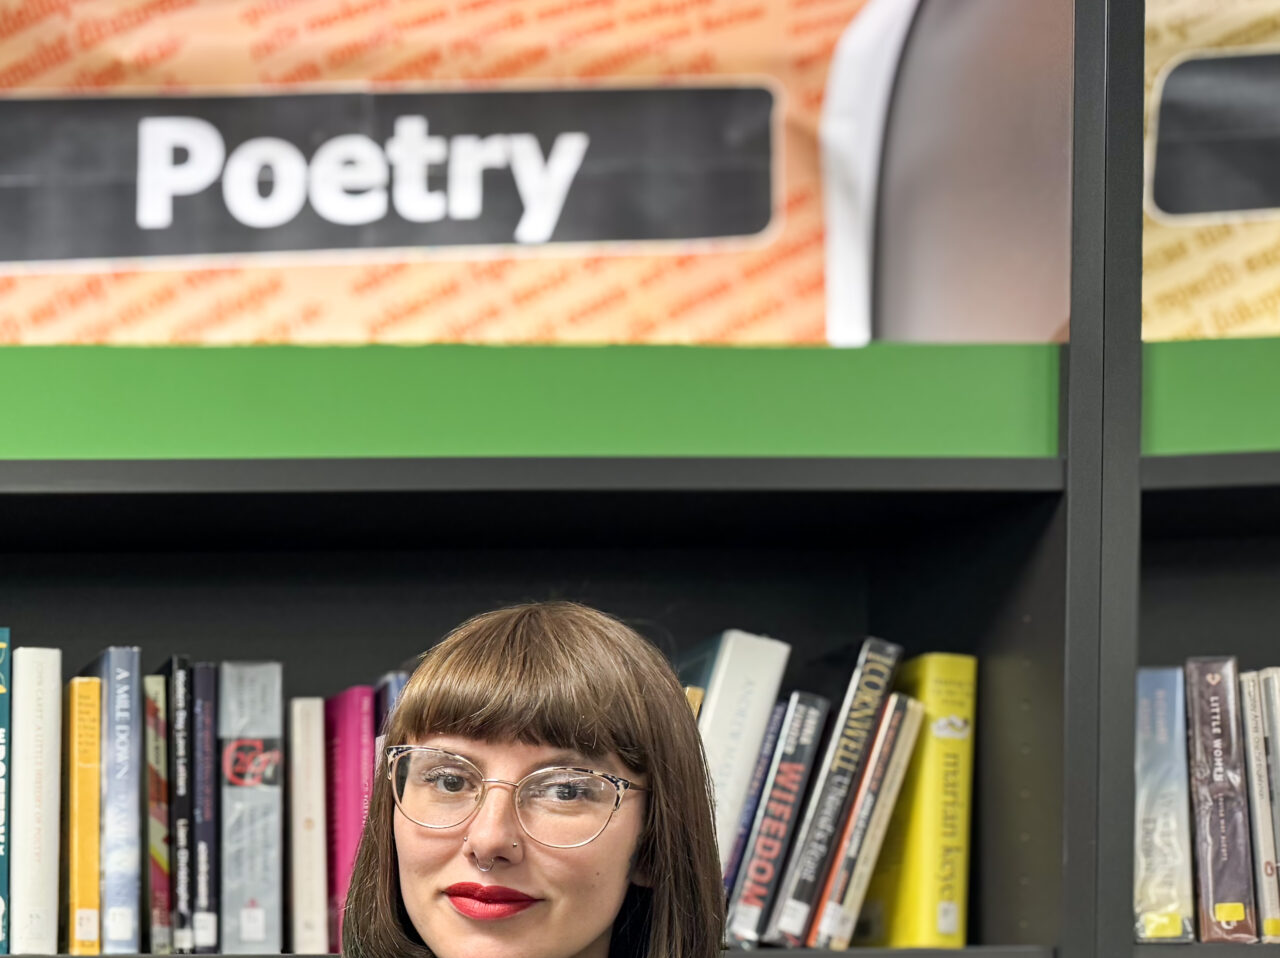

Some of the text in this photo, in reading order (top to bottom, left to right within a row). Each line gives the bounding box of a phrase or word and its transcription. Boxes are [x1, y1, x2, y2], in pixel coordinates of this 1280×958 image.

[135, 115, 588, 245] Poetry
[115, 667, 131, 780] A DOWN
[1209, 695, 1225, 784] LITTLE WOMEN
[739, 760, 806, 909] WIFEDOM
[934, 752, 962, 902] marian keye
